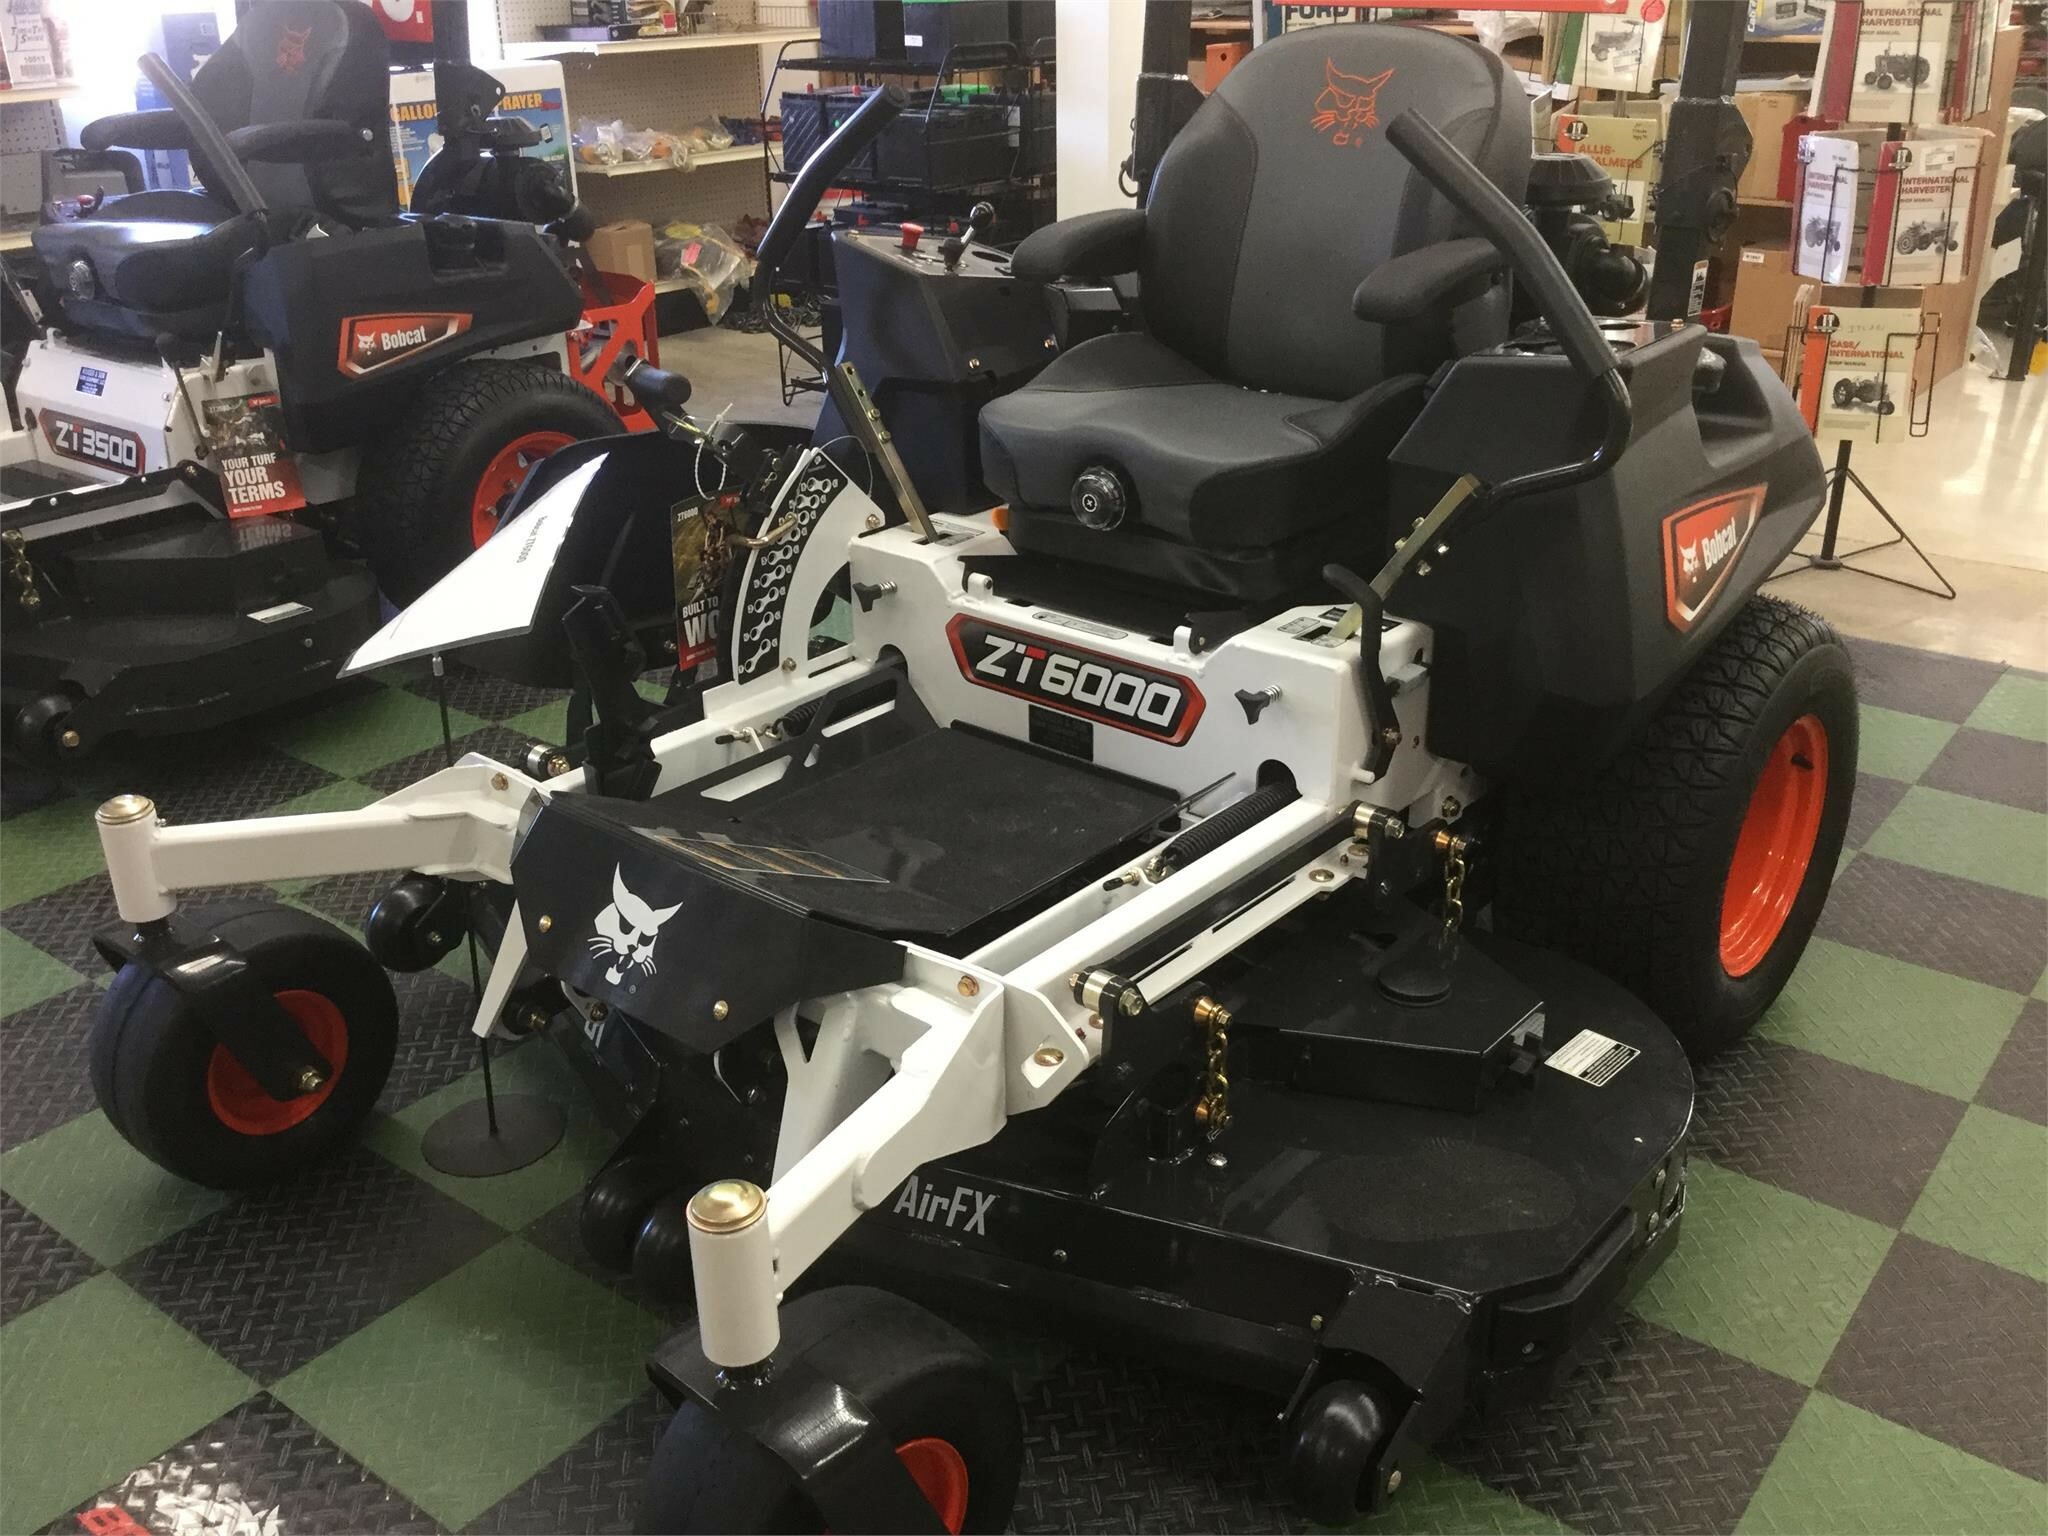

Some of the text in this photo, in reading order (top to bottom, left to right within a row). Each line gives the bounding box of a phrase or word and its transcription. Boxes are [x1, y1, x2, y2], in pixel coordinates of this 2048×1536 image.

[1861, 18, 1920, 26] HARVESTER
[1862, 8, 1943, 16] INTERNATIONAL
[496, 93, 542, 111] RAYER
[1579, 144, 1616, 155] ALLIS-
[1901, 186, 1951, 194] HARVESTER
[1902, 176, 1970, 185] INTERNATIONAL
[381, 325, 427, 351] Bobcat
[1829, 349, 1904, 359] INTERNATIONAL
[55, 420, 137, 468] ZT3500
[221, 452, 277, 471] YOUR TURF
[224, 466, 269, 488] YOUR
[228, 481, 286, 505] TERMS
[1701, 516, 1738, 571] Bobcat
[682, 595, 719, 619] BUILT TO
[974, 634, 1182, 728] ZT6000
[893, 1175, 997, 1236] AirFX
